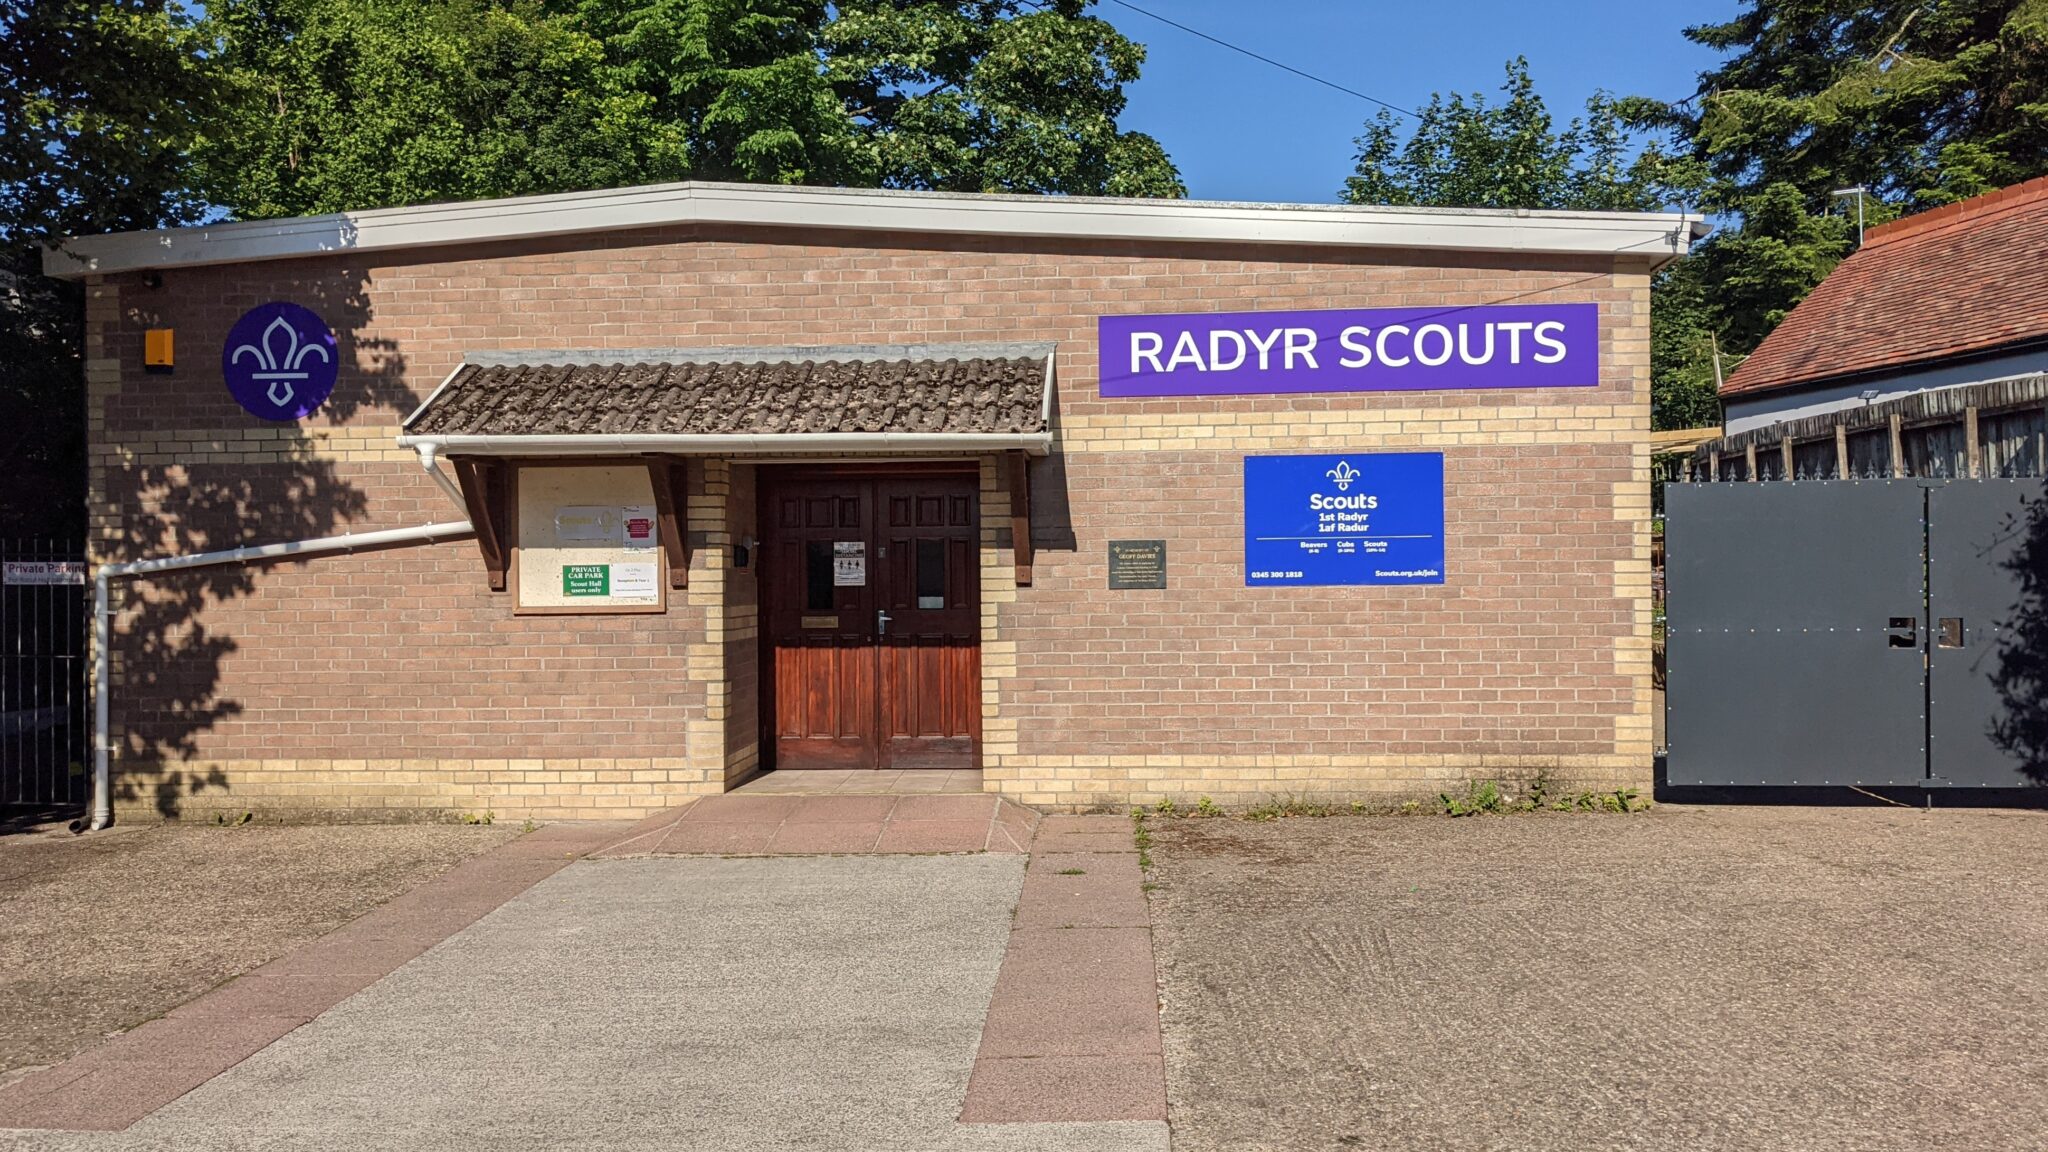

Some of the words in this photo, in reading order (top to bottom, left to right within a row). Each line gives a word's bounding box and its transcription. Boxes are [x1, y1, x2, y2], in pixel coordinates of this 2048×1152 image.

[1129, 328, 1320, 374] RADYR
[1338, 321, 1567, 369] SCOUTS
[1310, 493, 1378, 510] Scouts
[1318, 513, 1335, 522] 1st
[1337, 512, 1368, 523] Radyr
[1318, 523, 1336, 533] 1af
[1337, 523, 1369, 532] Radur
[1300, 541, 1328, 549] Beavers
[8, 563, 45, 574] Private
[1375, 569, 1438, 578] Scouts.org.uk/join
[1251, 571, 1269, 579] 0345
